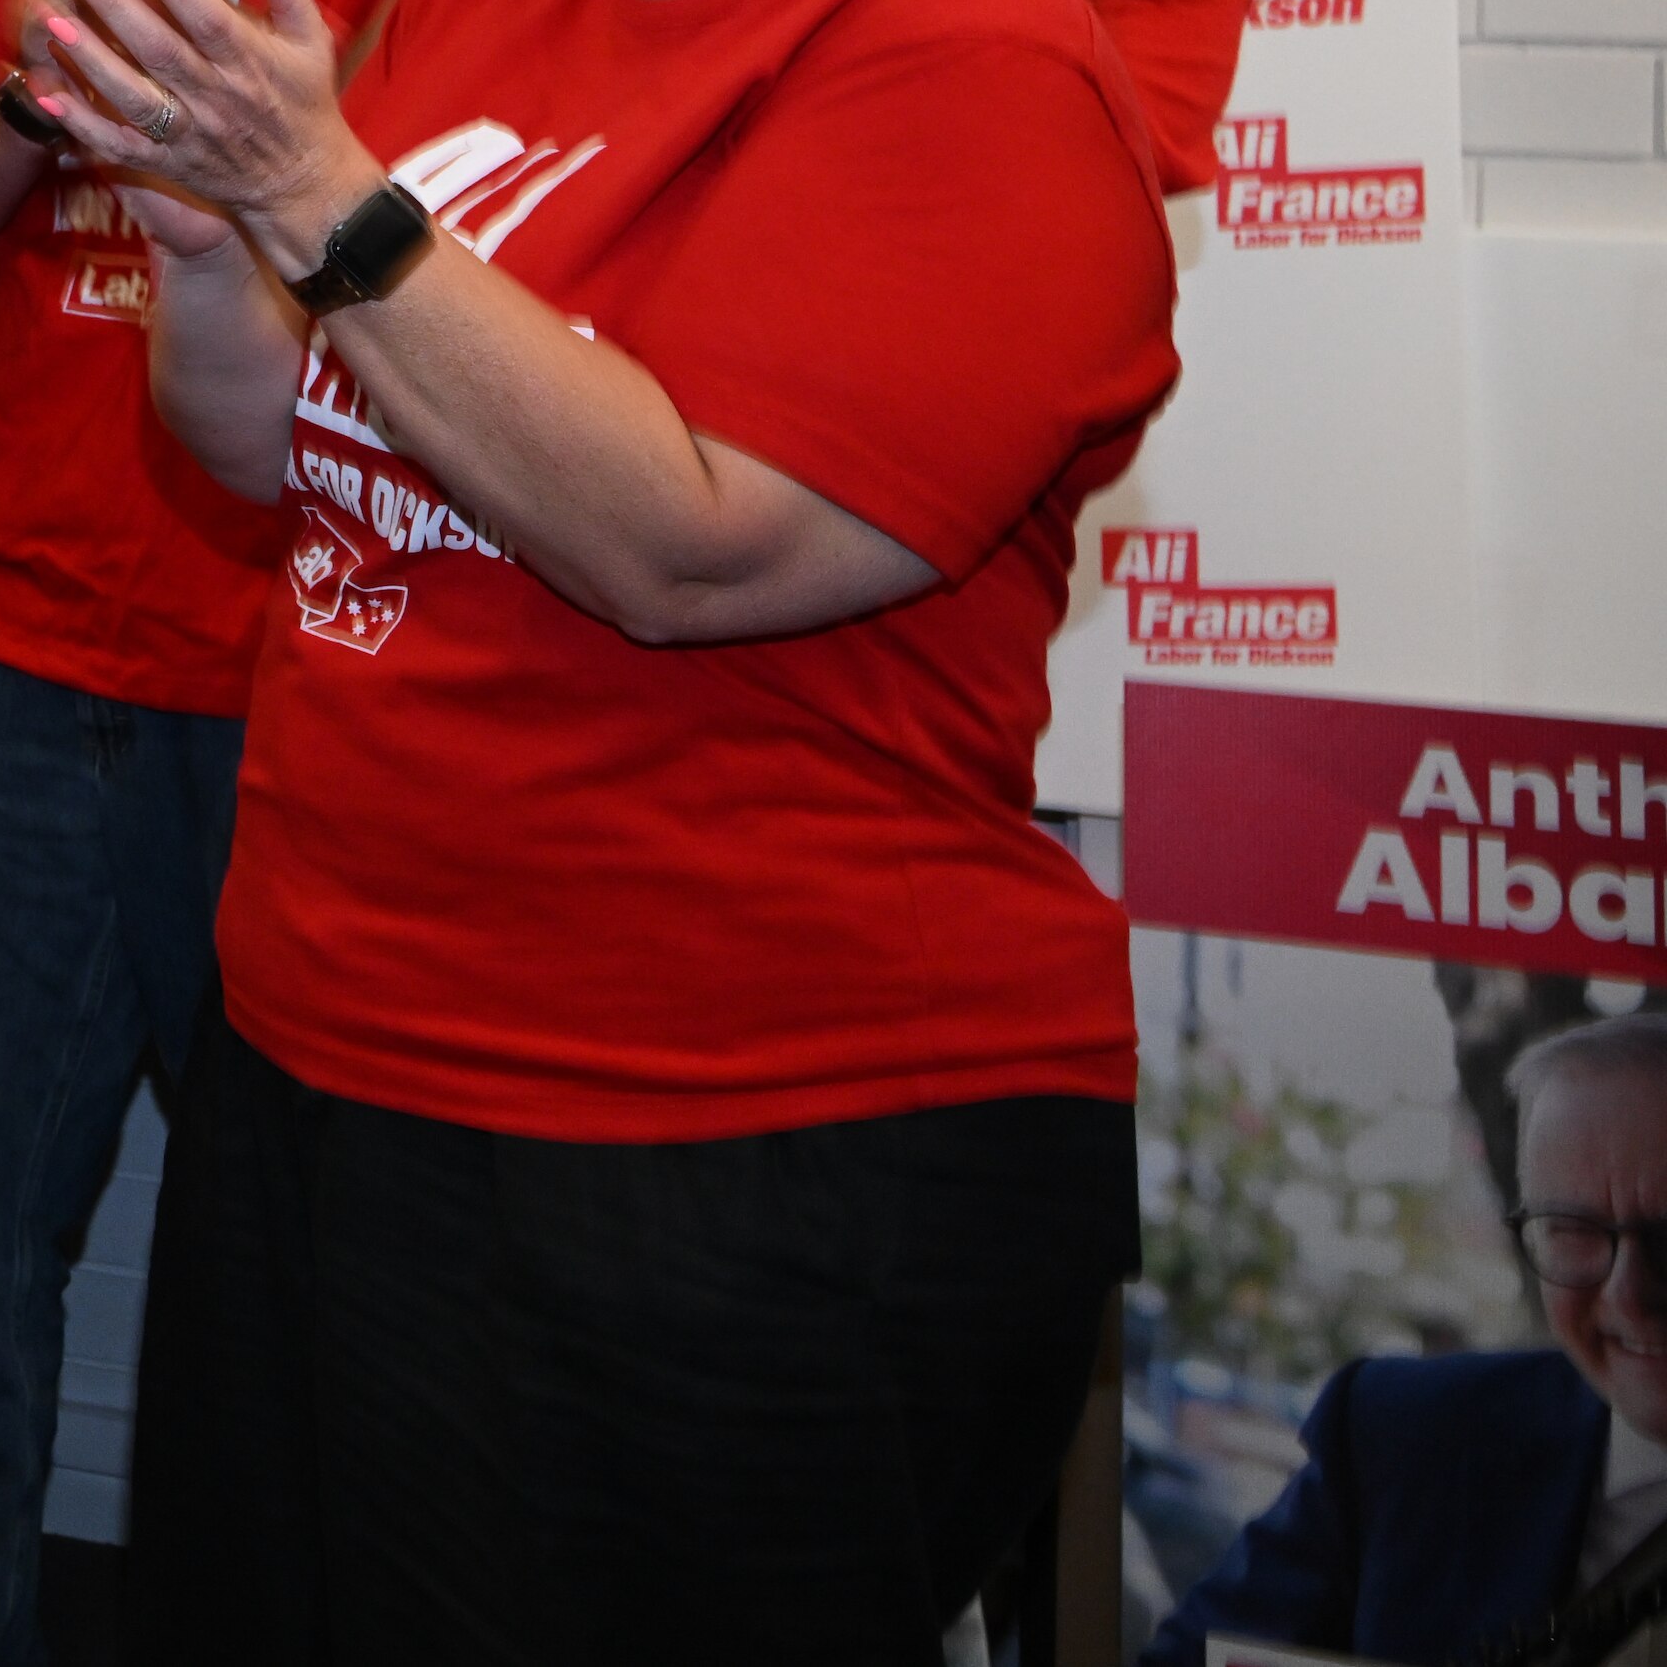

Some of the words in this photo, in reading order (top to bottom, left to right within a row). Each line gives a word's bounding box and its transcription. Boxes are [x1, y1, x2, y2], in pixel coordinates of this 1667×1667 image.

[1215, 124, 1279, 170] Ali
[1227, 176, 1417, 224] France
[1235, 227, 1290, 249] Labor
[1302, 227, 1327, 247] for
[1338, 225, 1422, 246] Dickson
[302, 449, 367, 525] FOR
[1113, 536, 1188, 583] Ali
[1138, 591, 1330, 641] France
[1146, 646, 1201, 666] Labor
[1212, 646, 1238, 666] for
[1249, 646, 1334, 666] Dickson
[1335, 831, 1667, 947] Alba
